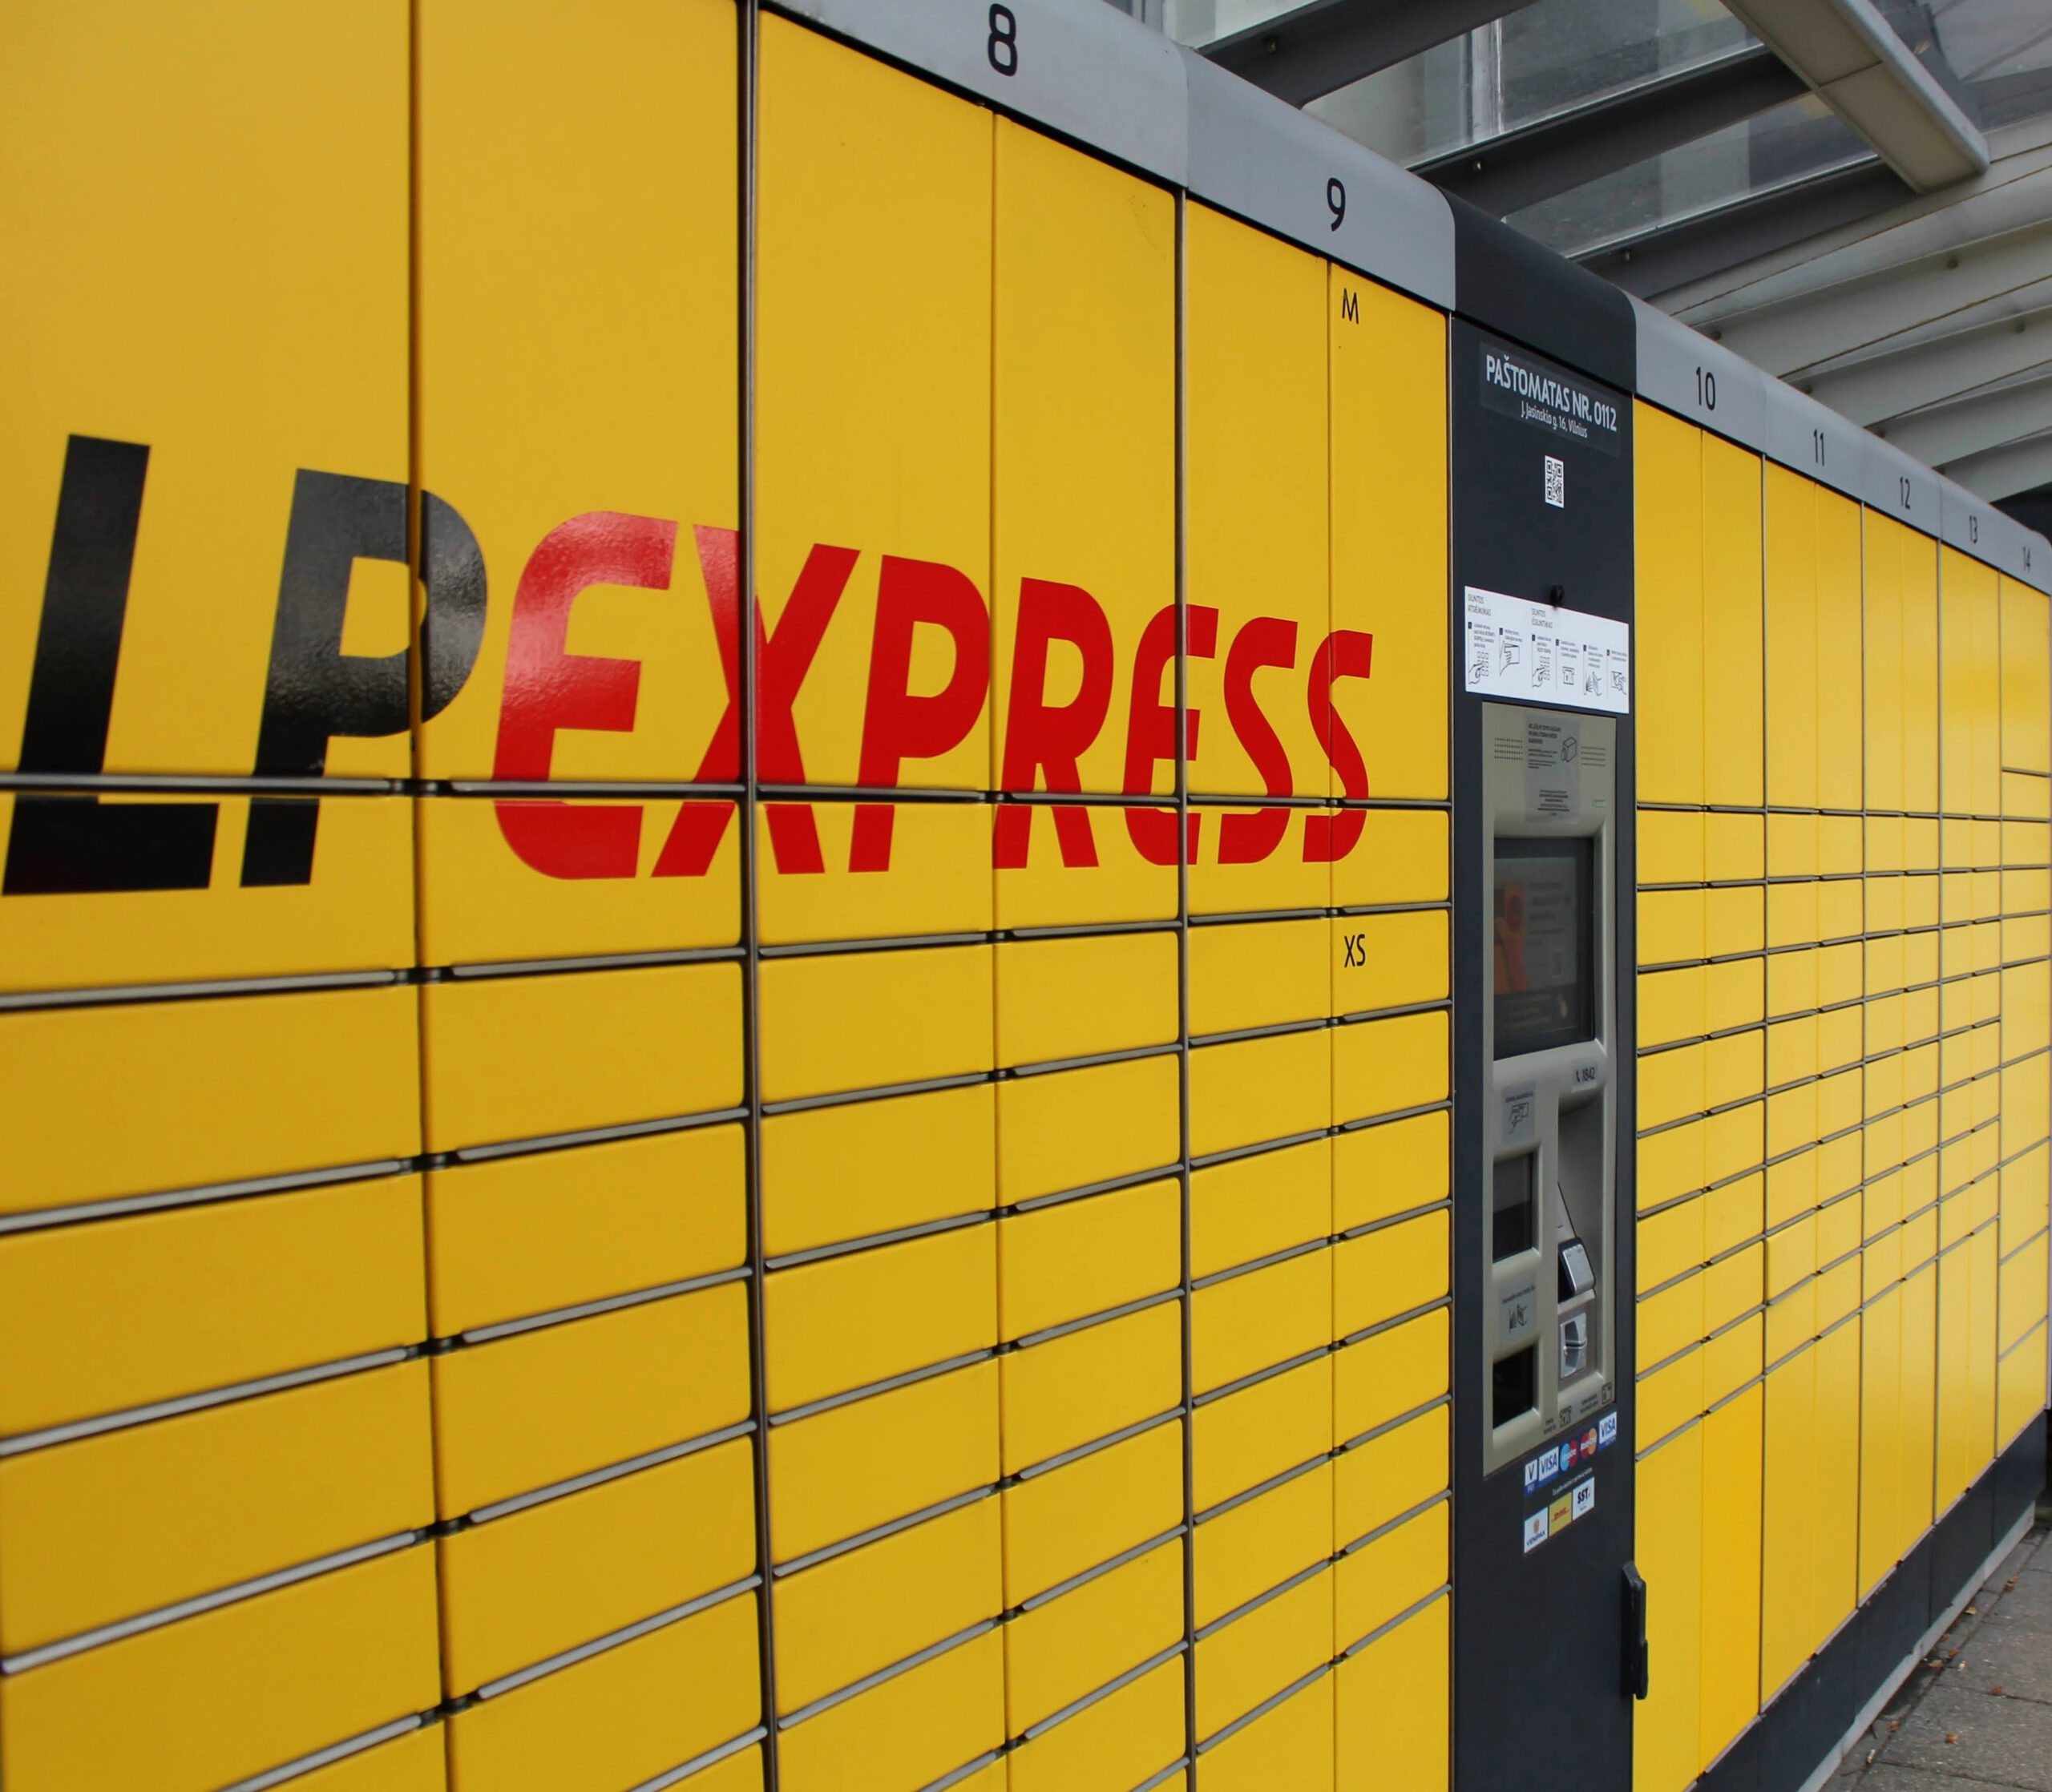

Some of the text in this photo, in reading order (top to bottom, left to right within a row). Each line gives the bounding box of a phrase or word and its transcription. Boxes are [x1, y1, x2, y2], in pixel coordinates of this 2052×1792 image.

[987, 2, 1017, 77] 8
[1327, 177, 1346, 232] 9
[1342, 288, 1359, 325] M
[1486, 354, 1617, 432] PAŠTOMATAS NR. 0112
[1695, 366, 1716, 411] 10
[1525, 402, 1553, 425] Jasinskio
[1568, 418, 1587, 438] Vilnius
[1813, 429, 1825, 466] 11
[1899, 476, 1911, 510] 12
[1969, 515, 1978, 544] 13
[2022, 546, 2031, 572] 14
[1343, 934, 1366, 968] XS
[1601, 1418, 1616, 1438] VISA
[1527, 1463, 1534, 1480] V
[1541, 1455, 1557, 1475] VISA
